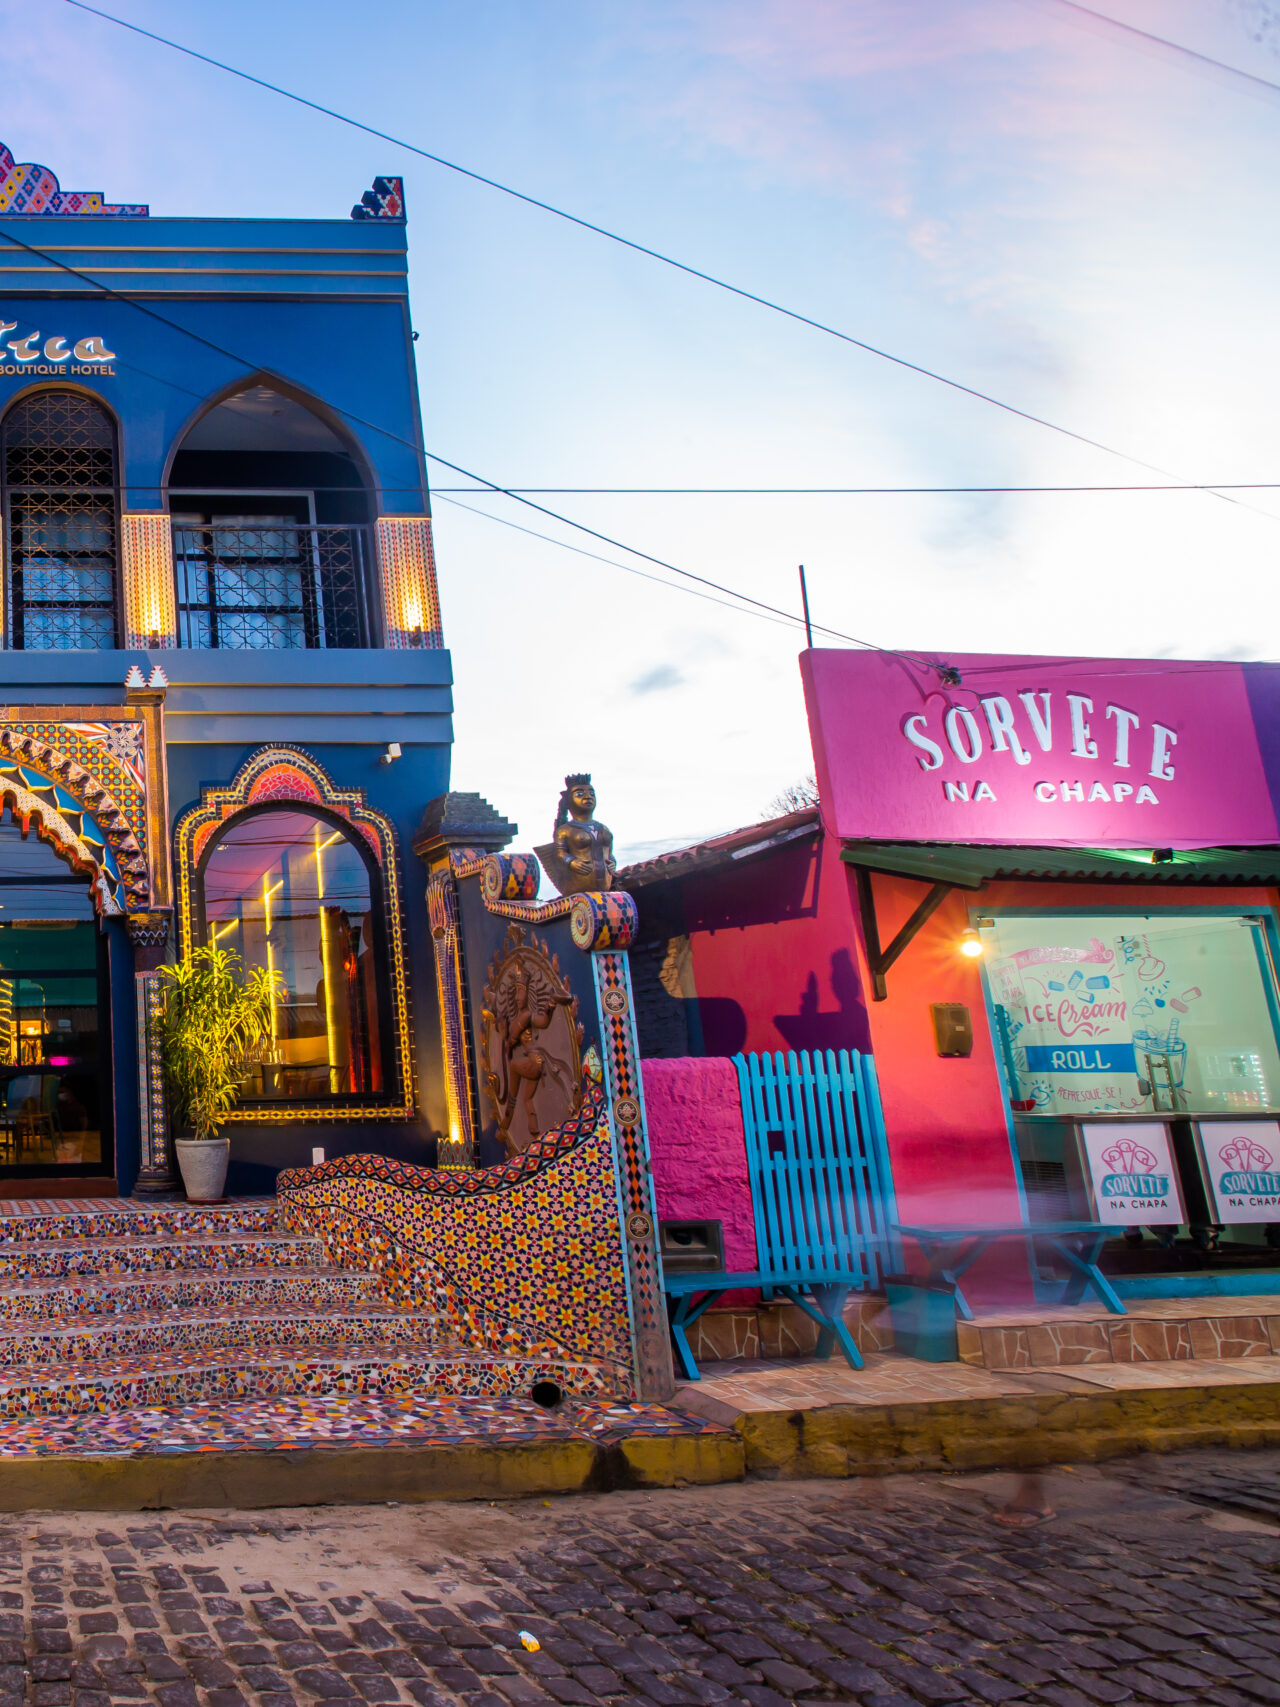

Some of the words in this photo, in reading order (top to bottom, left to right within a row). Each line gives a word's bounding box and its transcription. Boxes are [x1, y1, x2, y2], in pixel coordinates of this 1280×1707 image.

[71, 364, 115, 376] HOTEL
[903, 692, 1178, 781] SORVETE
[944, 781, 997, 803] NA
[1034, 781, 1159, 805] CHAPA
[1024, 1003, 1056, 1024] ICE
[1057, 999, 1127, 1038] Cream
[1051, 1050, 1111, 1069] ROLL
[1105, 1175, 1164, 1196] SORVETE
[1224, 1173, 1280, 1194] SORVETE
[1110, 1199, 1126, 1209] NA
[1131, 1199, 1168, 1208] CHAPA
[1229, 1198, 1244, 1207] NA
